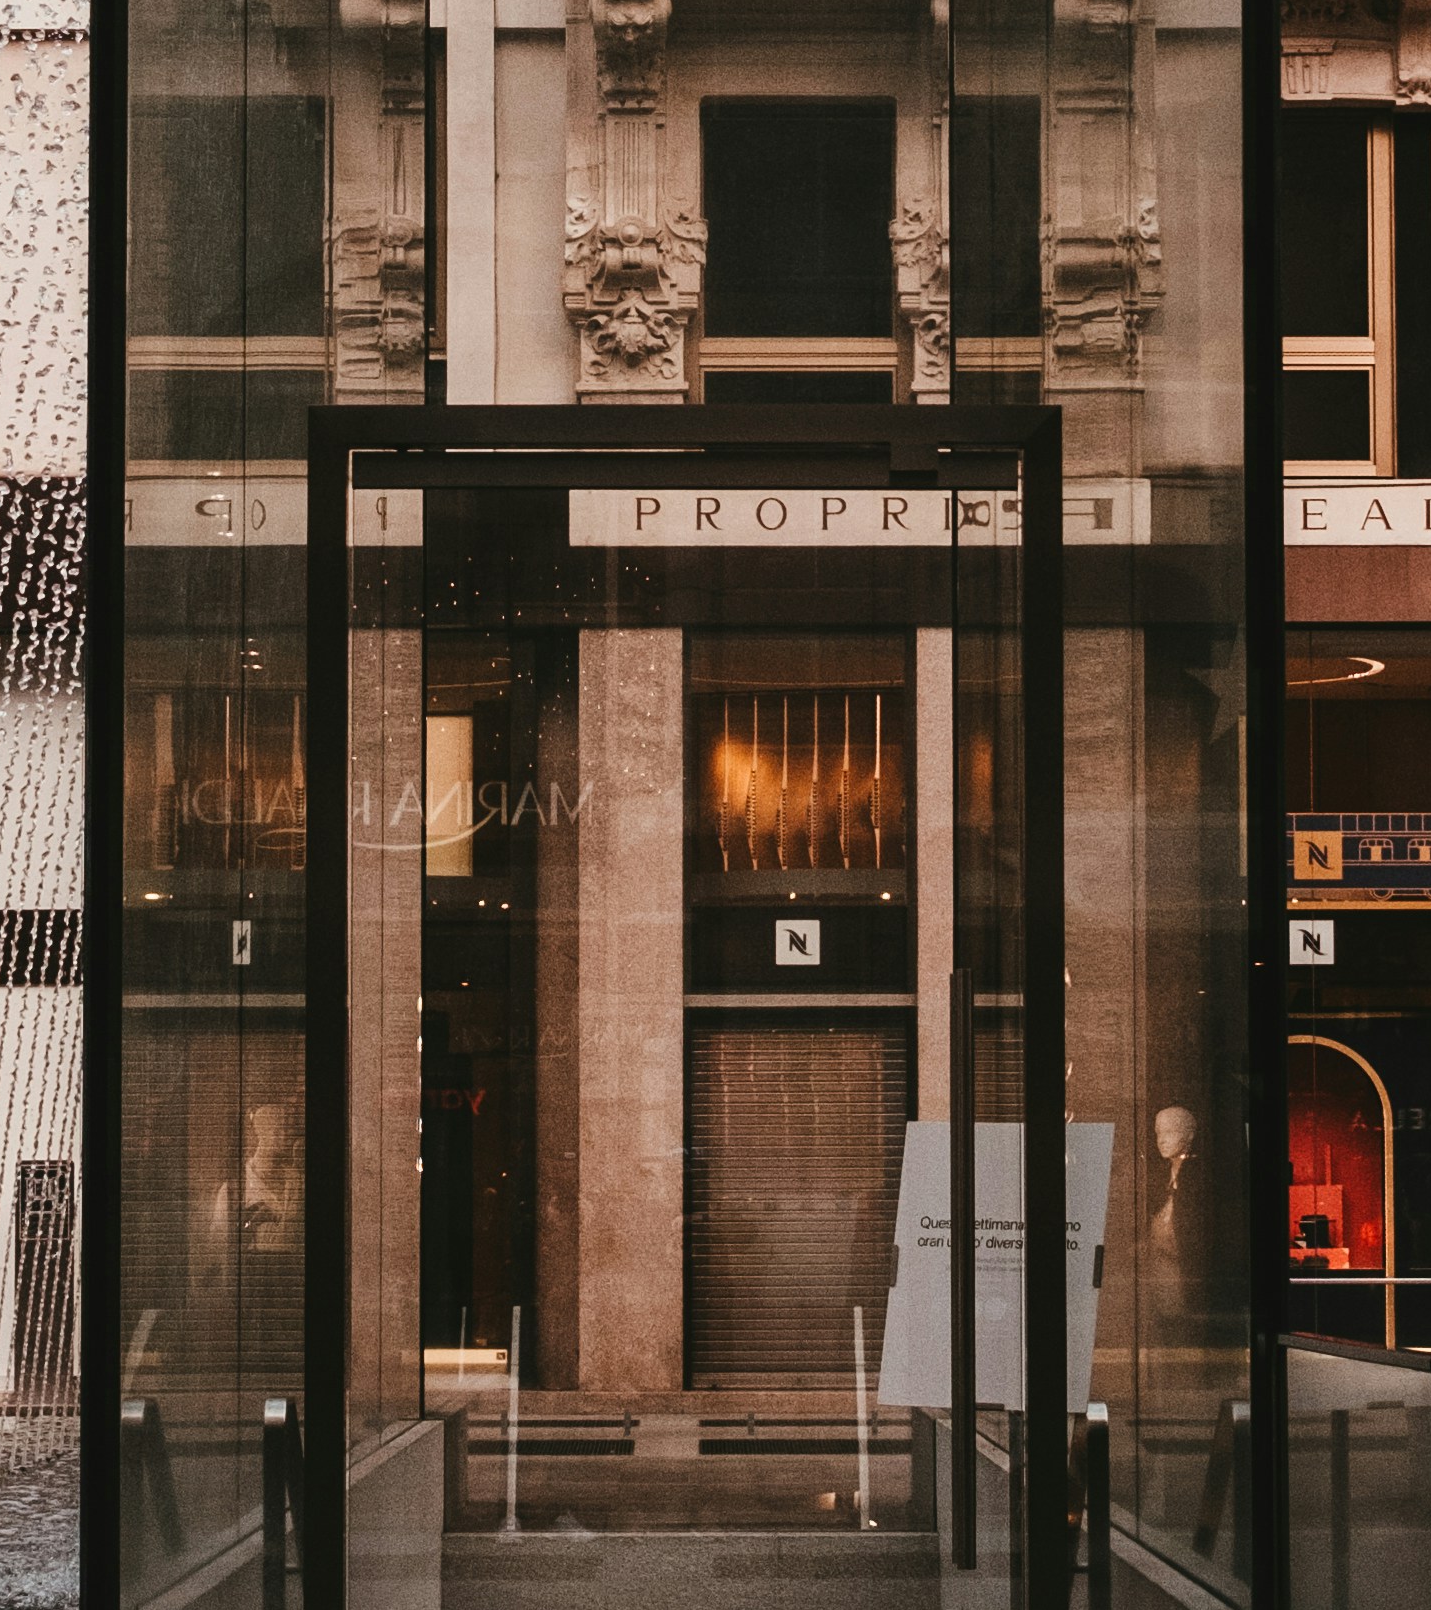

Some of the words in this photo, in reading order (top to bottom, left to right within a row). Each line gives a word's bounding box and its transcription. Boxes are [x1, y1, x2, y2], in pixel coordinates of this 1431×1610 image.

[635, 496, 953, 532] PROPRI
[920, 1215, 952, 1230] Ques
[974, 1217, 1025, 1231] ettimana
